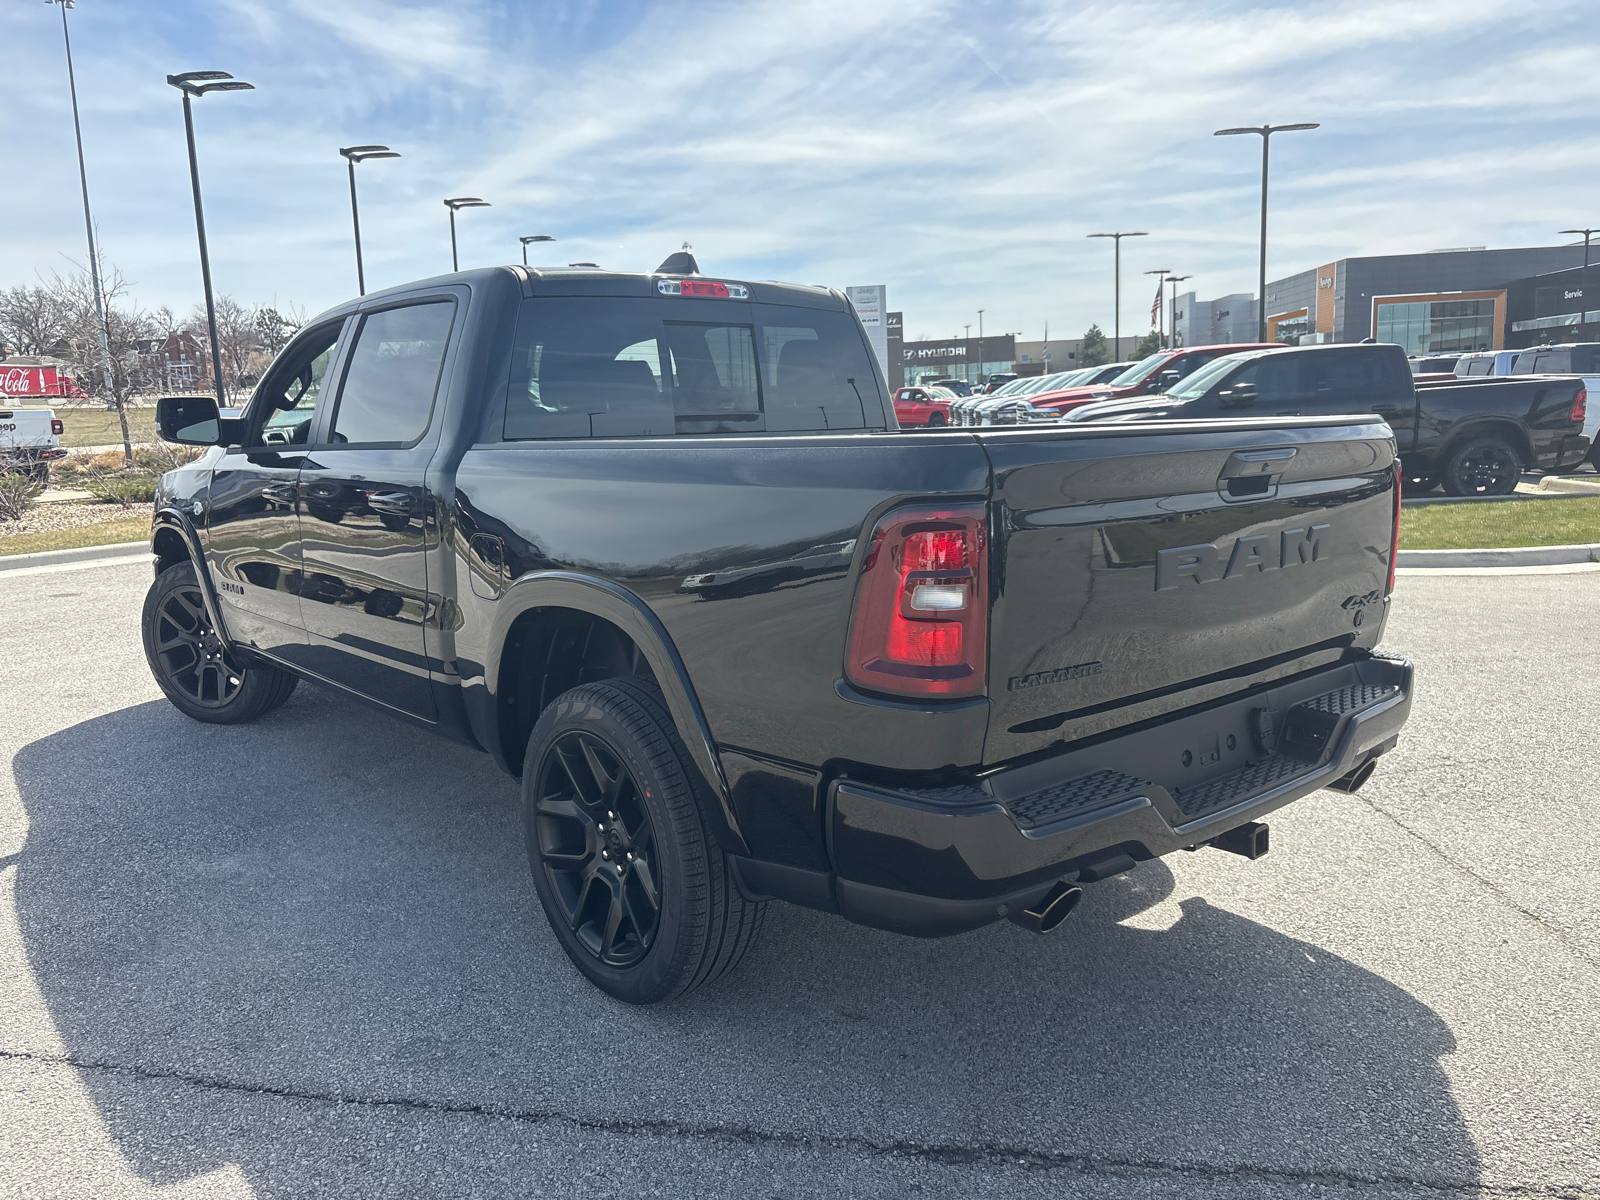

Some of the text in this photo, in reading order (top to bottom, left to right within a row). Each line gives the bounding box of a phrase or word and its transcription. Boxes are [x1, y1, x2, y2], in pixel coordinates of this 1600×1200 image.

[1564, 289, 1583, 299] Servic
[918, 347, 966, 358] HYUNDAI
[1154, 523, 1330, 592] RAM
[1007, 661, 1103, 692] LARAMIE
